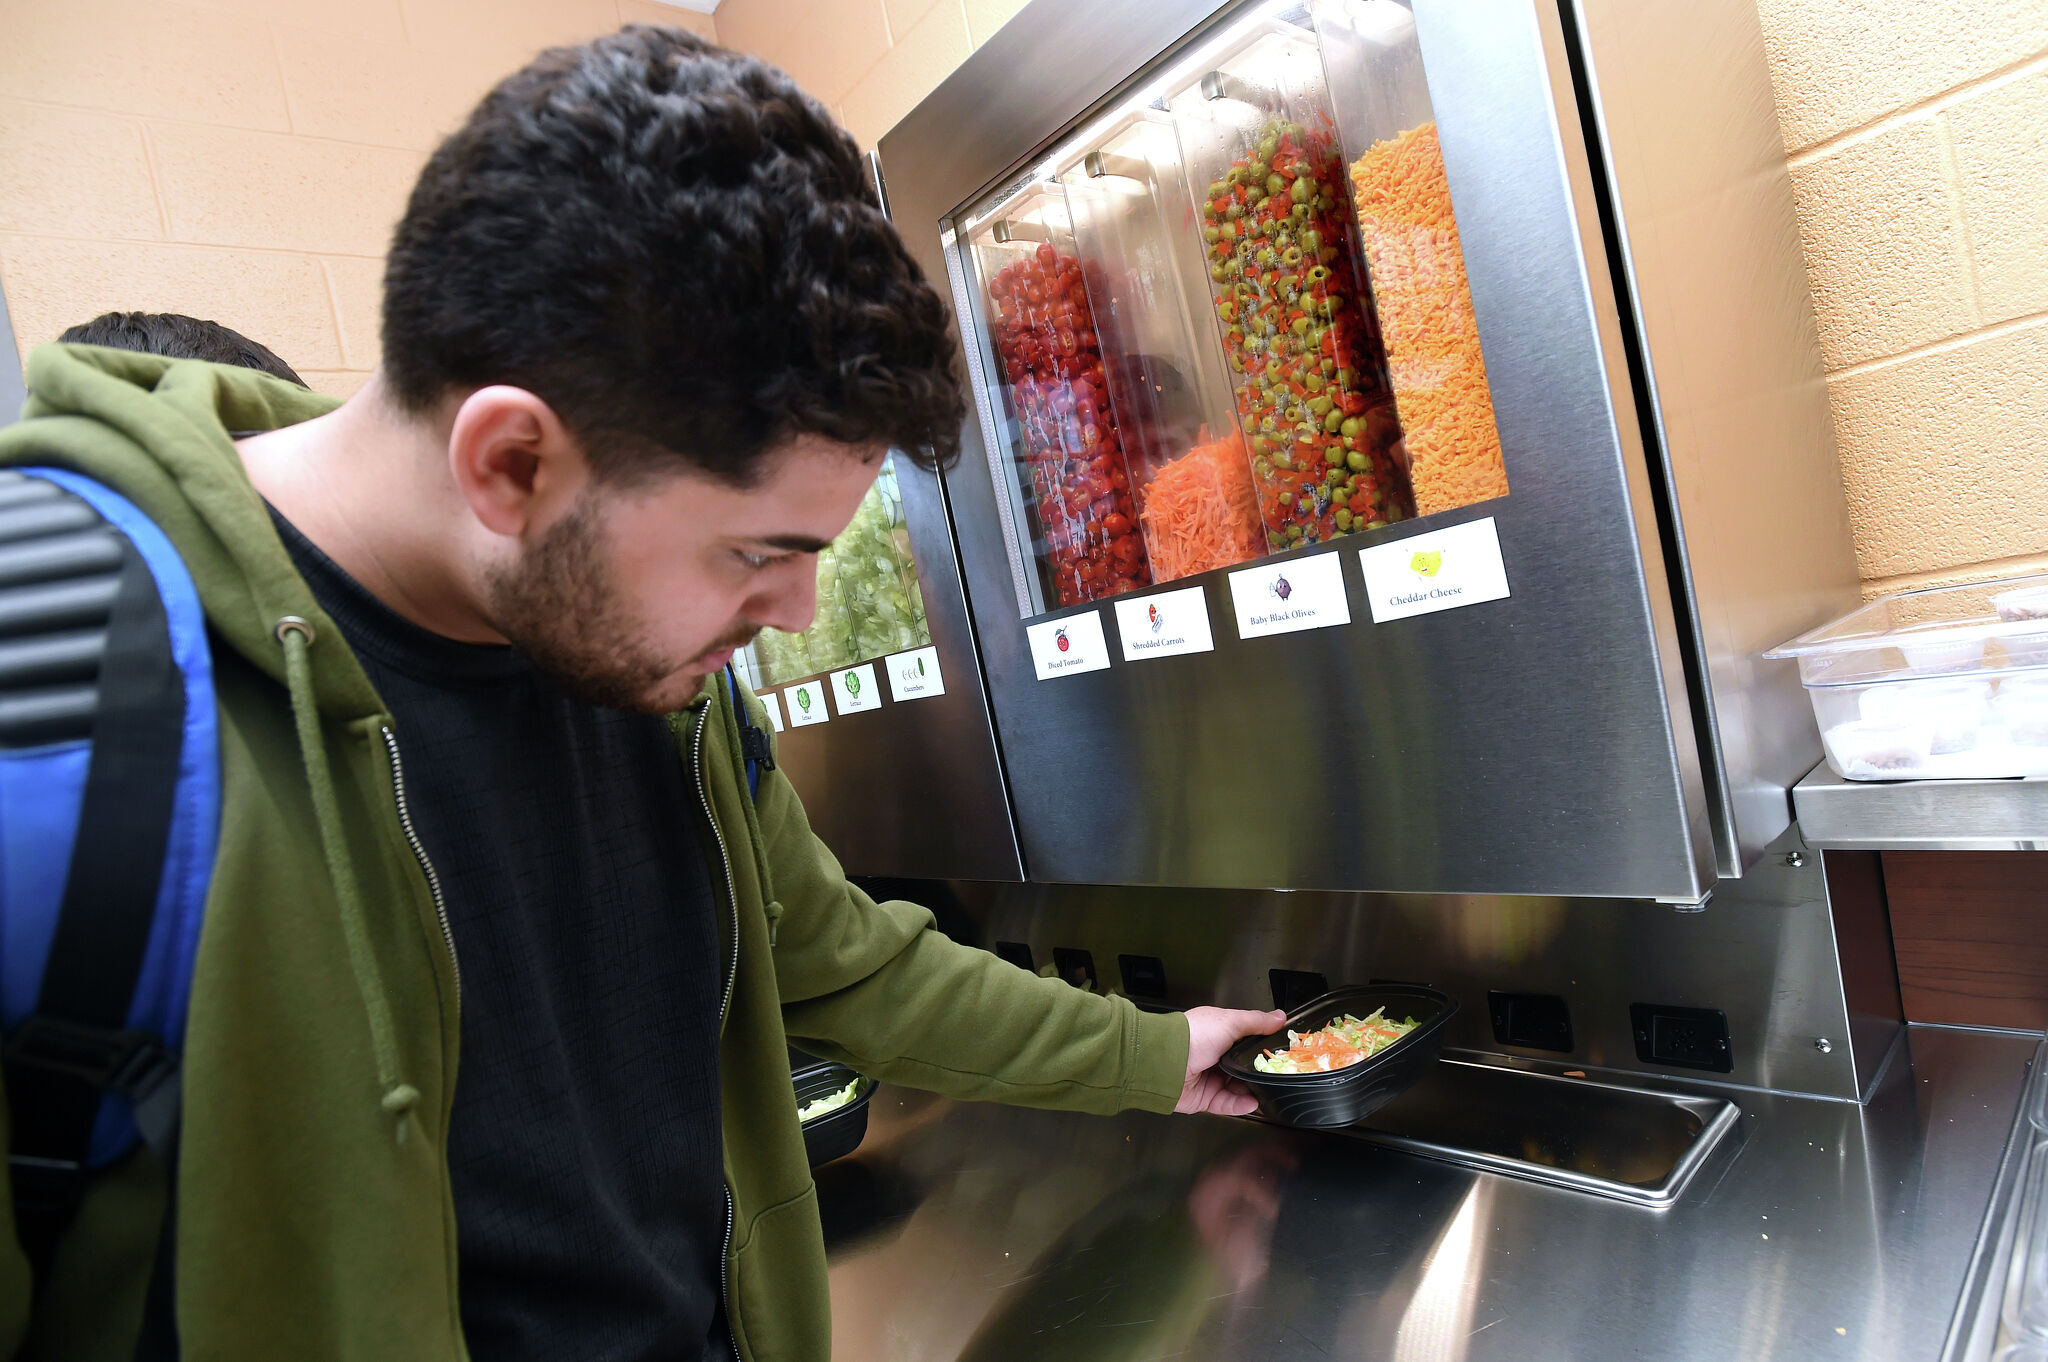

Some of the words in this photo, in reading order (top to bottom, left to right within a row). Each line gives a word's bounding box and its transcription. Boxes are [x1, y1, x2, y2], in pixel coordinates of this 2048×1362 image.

[1390, 592, 1428, 606] Cheddar
[1429, 587, 1463, 599] Cheese
[1250, 615, 1269, 626] Baby
[1269, 611, 1291, 623] Black
[1291, 609, 1317, 619] Olives
[1132, 639, 1161, 650] Shredded
[1161, 637, 1185, 647] Carrots
[1047, 660, 1063, 670] Diced
[1063, 658, 1084, 667] Tomato
